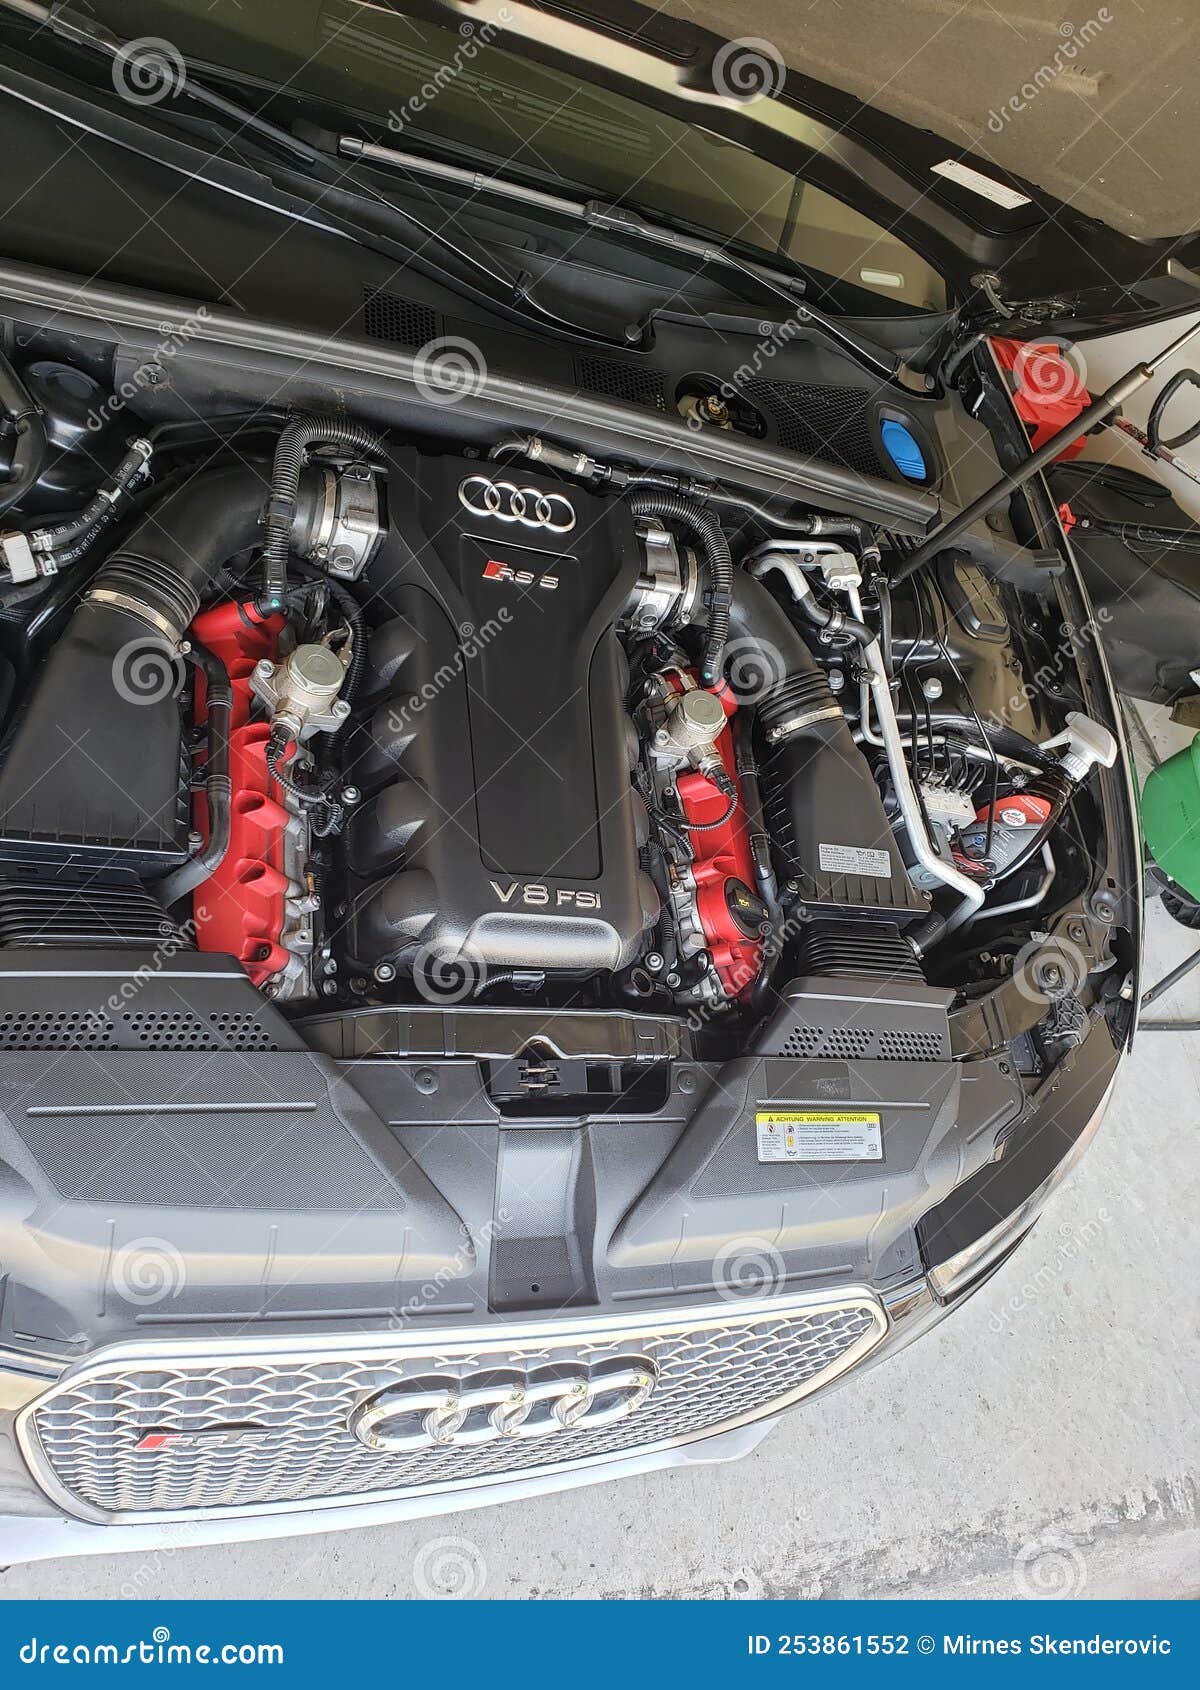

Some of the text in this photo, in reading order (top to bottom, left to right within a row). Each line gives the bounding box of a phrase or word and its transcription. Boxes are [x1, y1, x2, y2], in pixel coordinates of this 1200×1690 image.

[482, 560, 534, 584] RS
[489, 879, 602, 909] V8 FSI
